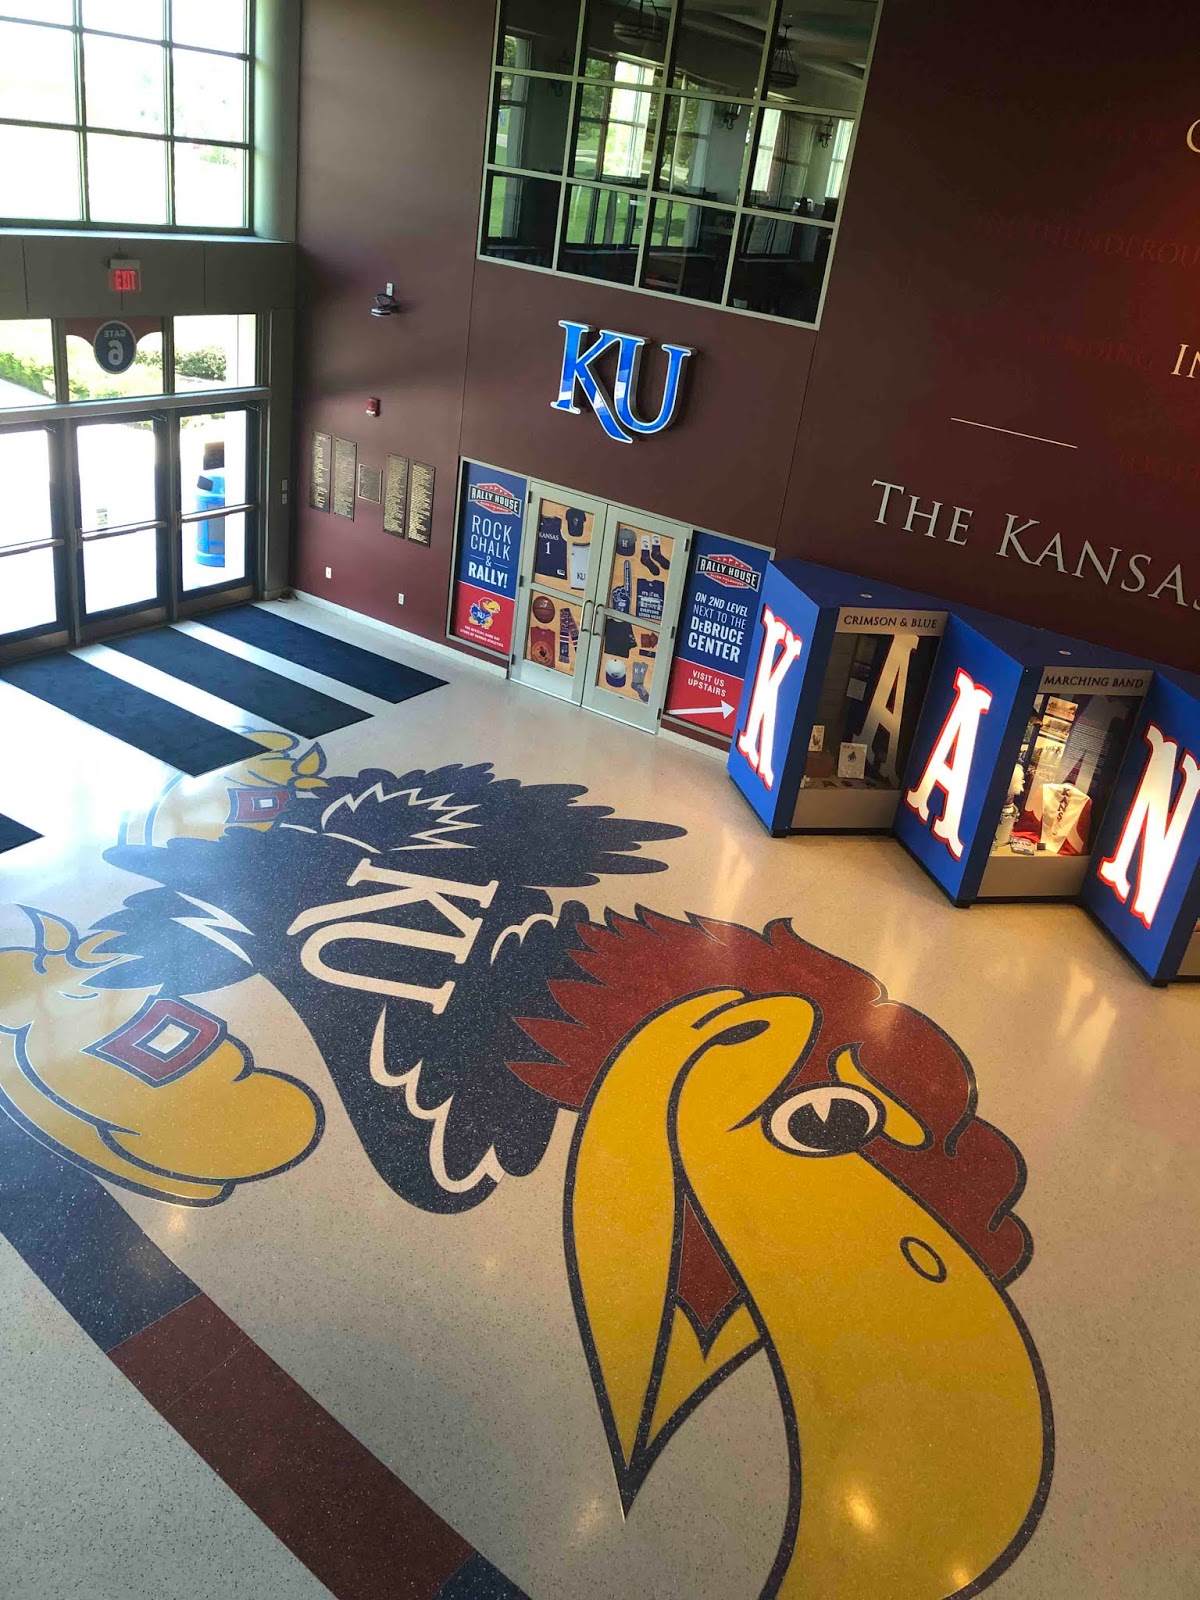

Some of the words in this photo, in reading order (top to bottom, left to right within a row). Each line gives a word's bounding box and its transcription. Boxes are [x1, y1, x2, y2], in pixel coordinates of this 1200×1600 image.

[114, 270, 136, 291] EXIT
[550, 319, 692, 444] KU
[471, 487, 493, 502] RALLY
[494, 494, 519, 513] HOUSE
[471, 514, 512, 545] ROCK
[539, 532, 559, 541] KANSAS
[470, 534, 511, 561] CHALK
[545, 541, 551, 555] 1
[871, 479, 974, 546] THE
[996, 513, 1200, 612] KANSA
[485, 555, 492, 567] &
[700, 558, 726, 574] RALLY
[728, 566, 757, 587] HOUSE
[468, 561, 508, 589] RALLY!
[693, 604, 714, 619] NEXT
[717, 611, 728, 624] TO
[730, 615, 747, 630] THE
[695, 591, 707, 604] ON
[709, 596, 725, 609] 2ND
[726, 601, 748, 618] LEVEL
[844, 615, 897, 627] CRIMSON
[900, 618, 908, 627] &
[911, 618, 938, 629] BLUE
[688, 632, 741, 663] CENTER
[687, 678, 727, 698] UPSTAIRS
[692, 669, 713, 682] VISIT
[714, 676, 725, 687] US
[1044, 676, 1109, 688] MARCHING
[1112, 678, 1144, 688] BAND
[736, 604, 802, 791] K
[906, 667, 993, 863] A
[286, 857, 500, 1015] KU
